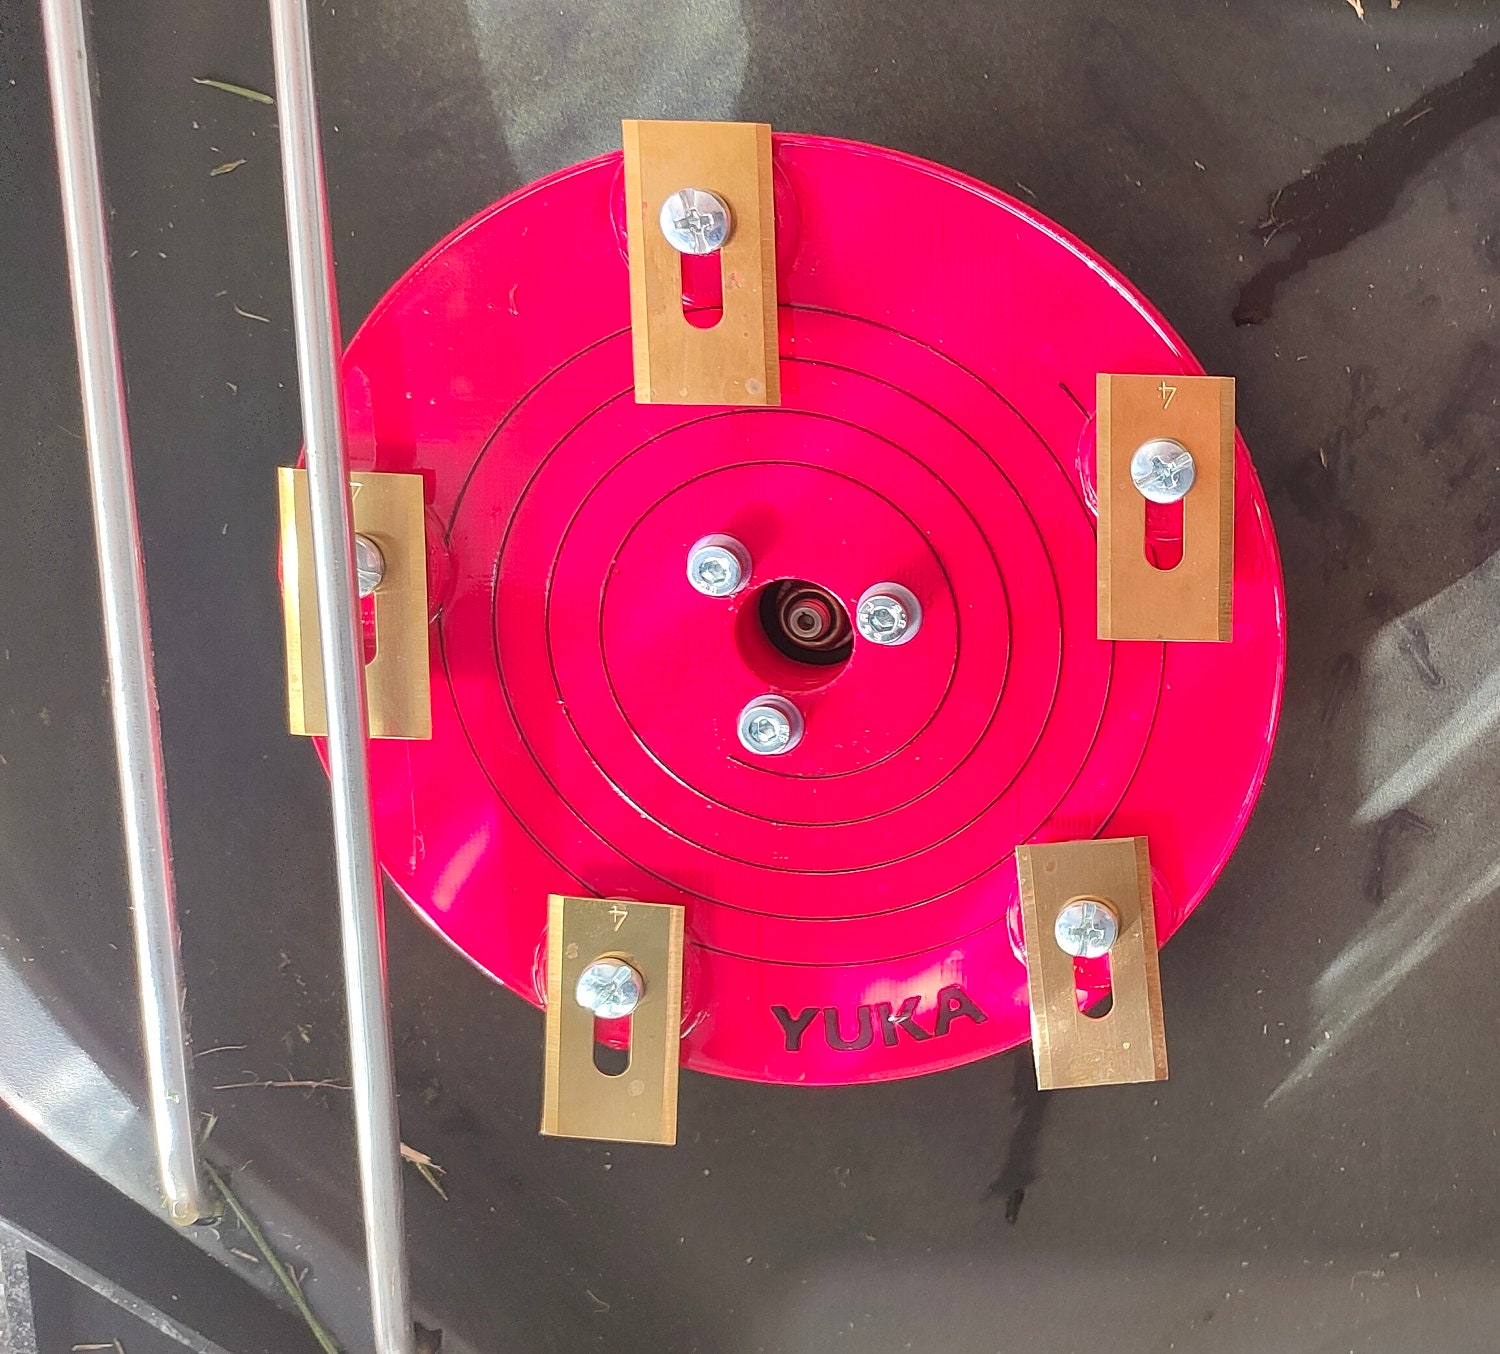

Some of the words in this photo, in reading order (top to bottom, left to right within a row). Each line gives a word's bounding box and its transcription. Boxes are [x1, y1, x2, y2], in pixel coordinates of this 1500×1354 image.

[1158, 380, 1177, 410] 4
[608, 904, 628, 932] 4
[771, 983, 988, 1052] YUKA
